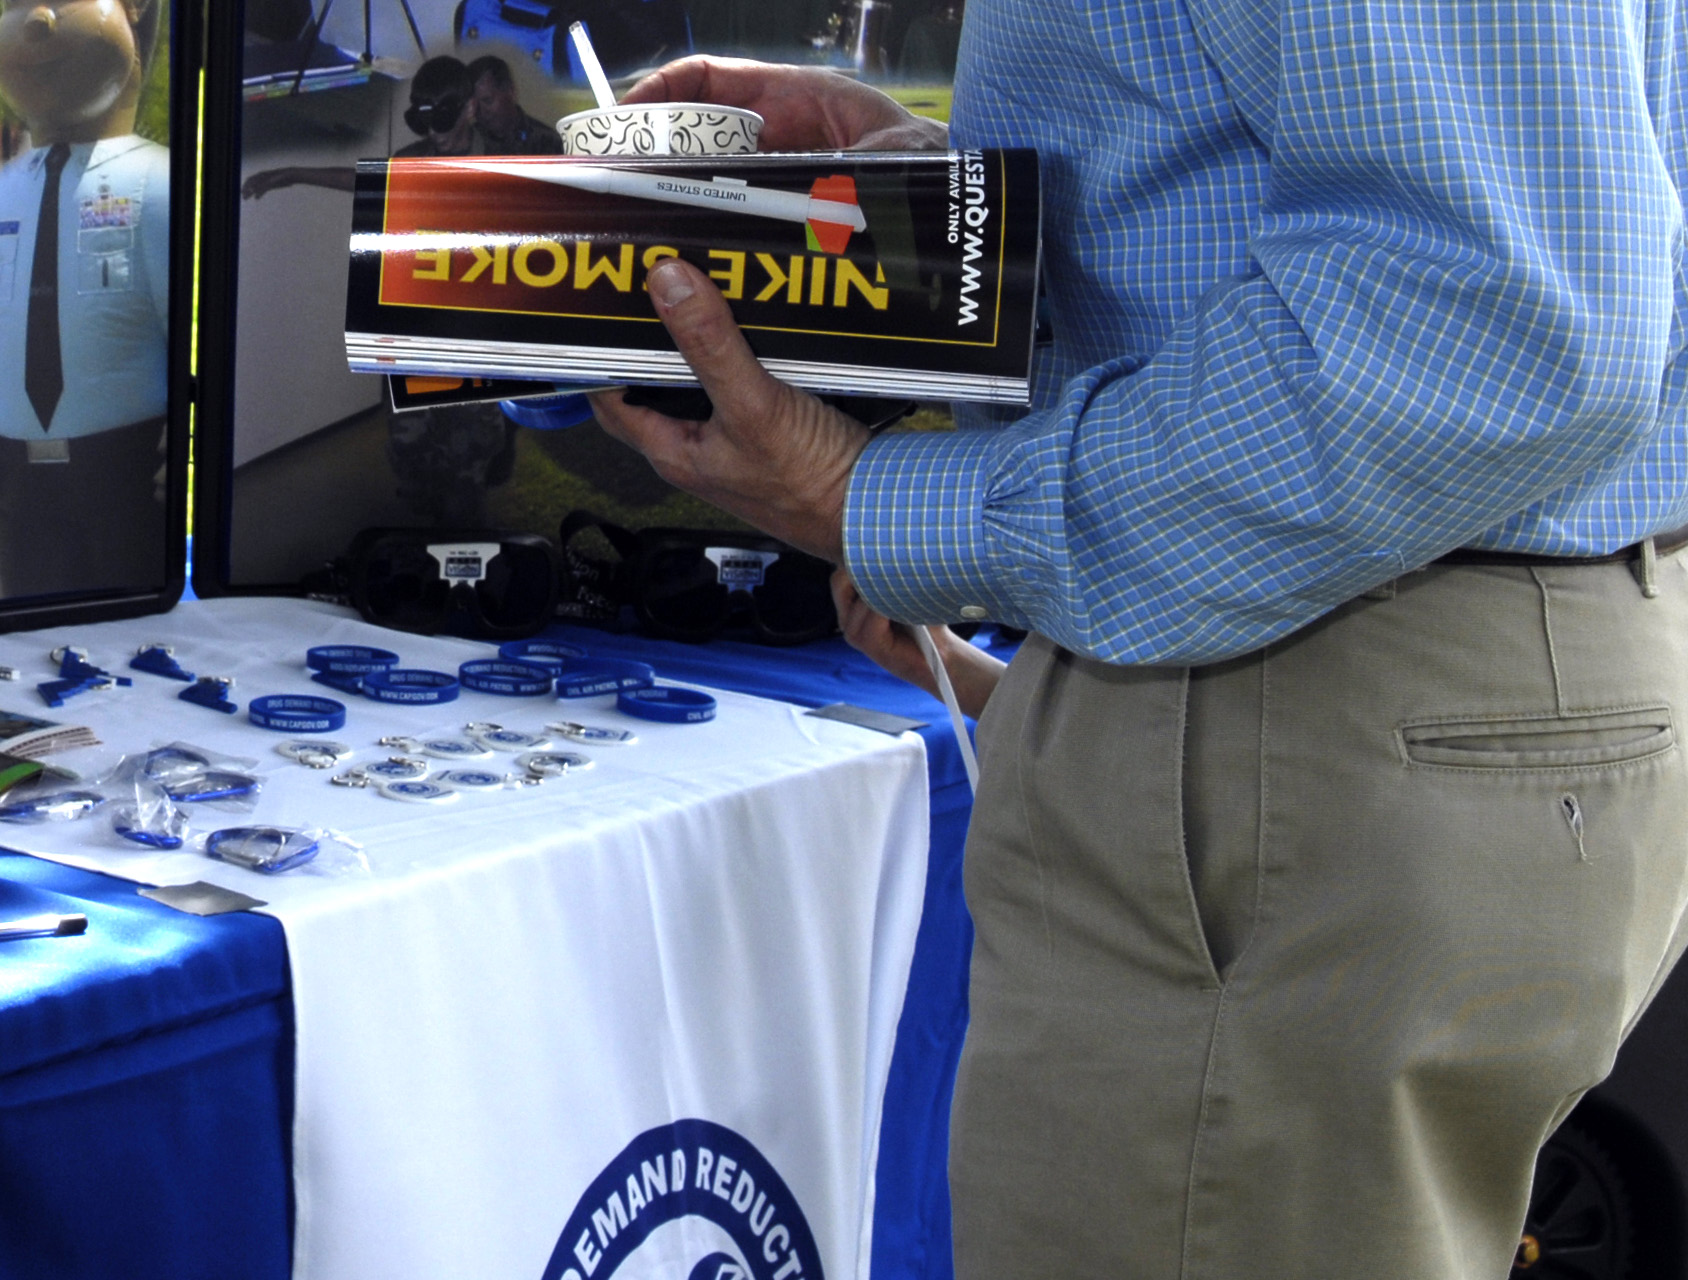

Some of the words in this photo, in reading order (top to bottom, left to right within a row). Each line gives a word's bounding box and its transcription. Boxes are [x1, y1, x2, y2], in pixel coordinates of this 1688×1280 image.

[657, 182, 700, 196] STATES
[703, 188, 747, 202] UNITED
[947, 203, 960, 244] ONLY
[708, 248, 889, 311] NIKE
